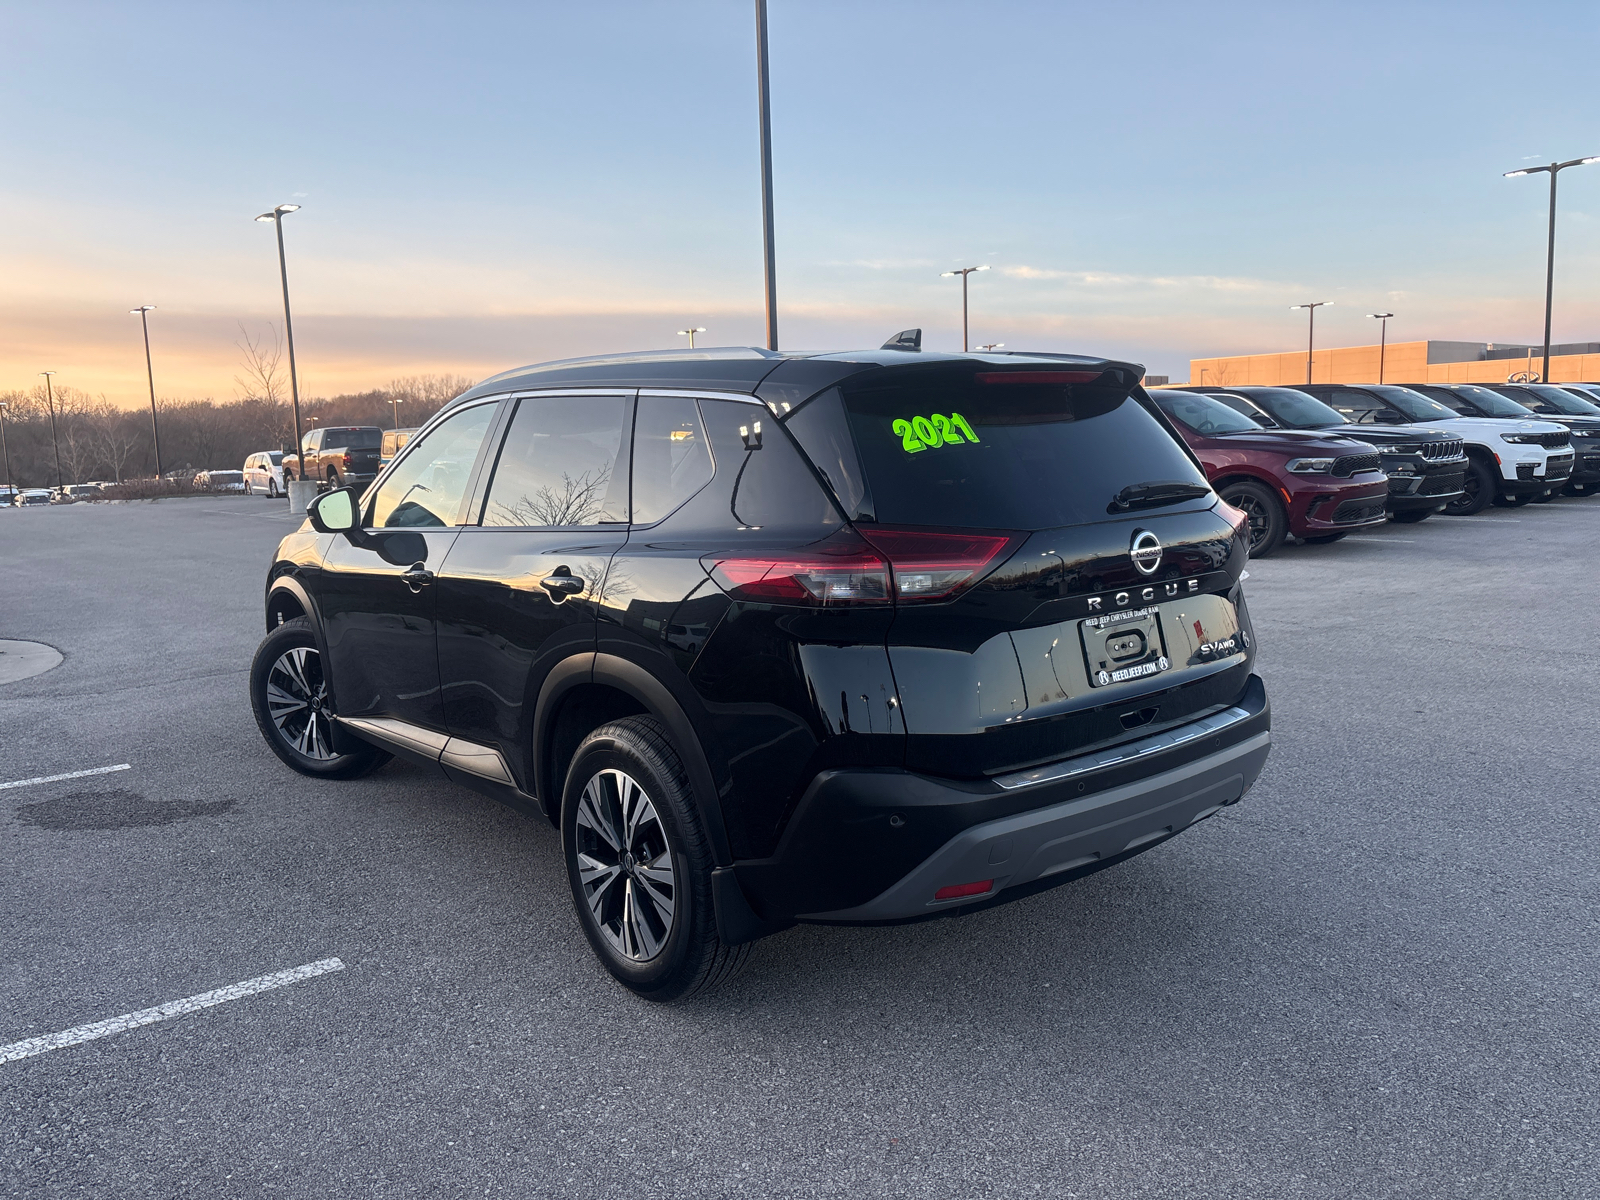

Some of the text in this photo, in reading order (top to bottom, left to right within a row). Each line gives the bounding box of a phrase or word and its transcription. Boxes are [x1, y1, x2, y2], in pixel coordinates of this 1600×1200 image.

[892, 413, 980, 453] 2021
[1136, 549, 1162, 558] NISSAN
[1087, 580, 1199, 611] ROGUE
[1085, 617, 1098, 627] REED
[1099, 615, 1110, 625] JEEP
[1110, 610, 1134, 622] CHRYSLER
[1148, 606, 1160, 615] RAM
[1200, 639, 1235, 653] SV AWD
[1111, 662, 1157, 682] REEDJEEP.COM
